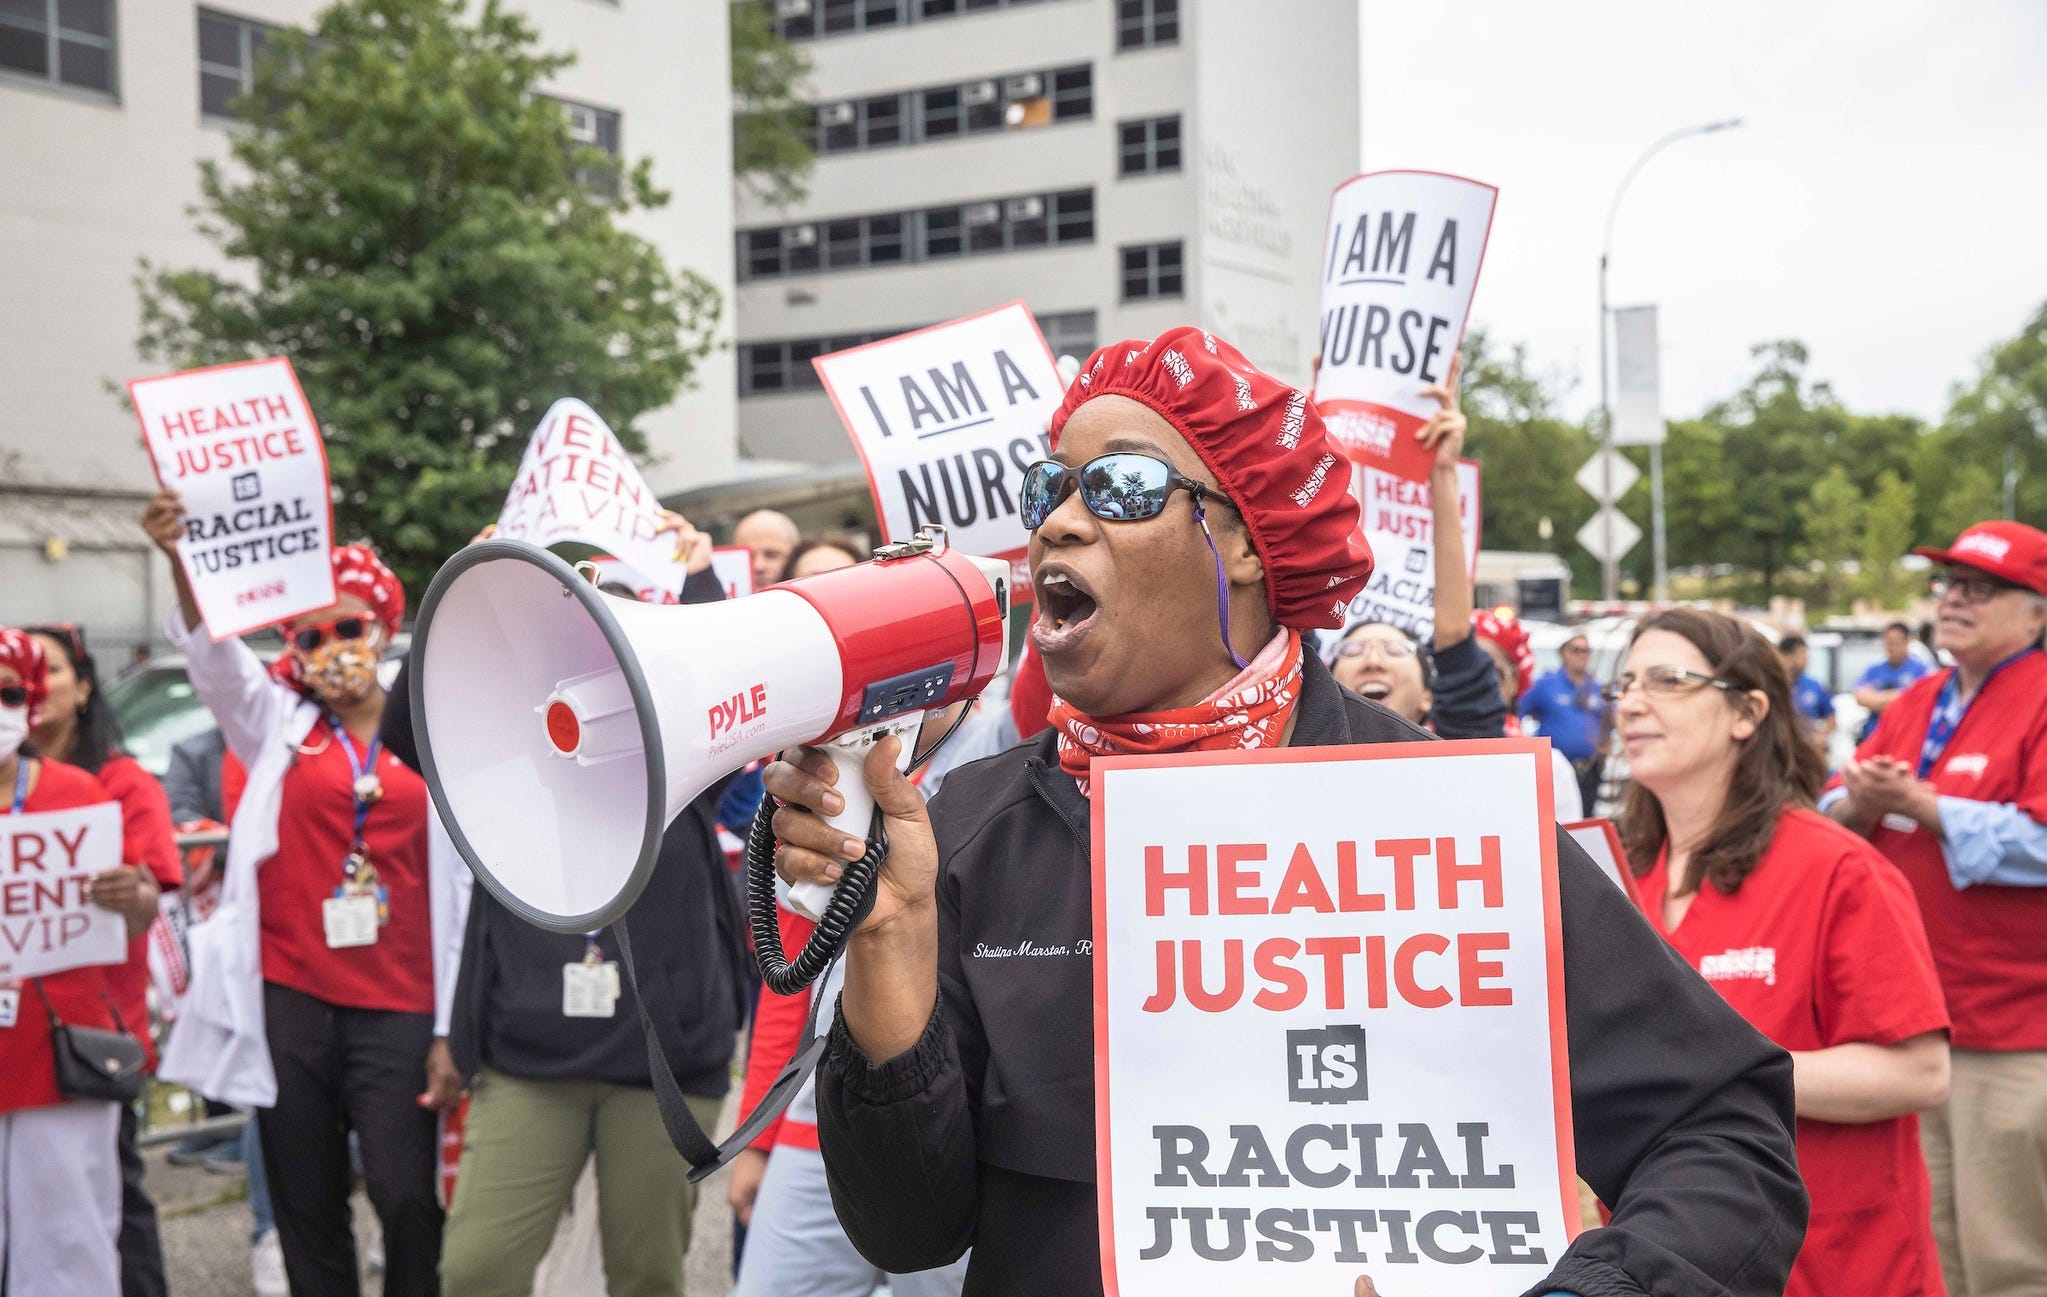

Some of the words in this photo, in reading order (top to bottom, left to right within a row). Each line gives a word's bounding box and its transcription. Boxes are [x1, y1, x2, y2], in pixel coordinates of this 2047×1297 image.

[1327, 223, 1342, 284] I
[1343, 211, 1417, 275] AM
[1427, 219, 1459, 286] A
[161, 394, 291, 442] HEALTH
[859, 386, 892, 437] I
[899, 361, 989, 430] AM
[993, 350, 1041, 406] A
[1281, 390, 1307, 450] NURSES
[176, 428, 306, 478] JUSTICE
[1295, 453, 1337, 508] NURSES
[898, 432, 1053, 534] NURS
[186, 500, 312, 543] RACIAL
[1377, 511, 1430, 542] JUST
[192, 527, 321, 577] JUSTICE
[708, 683, 767, 741] PYLE
[0, 826, 89, 875] RY
[1144, 836, 1504, 916] HEALTH
[1, 911, 91, 954] VIP
[1013, 940, 1070, 957] Marston,
[1142, 932, 1513, 1013] JUSTICE
[1297, 1044, 1359, 1089] IS
[1152, 1122, 1516, 1189] RACIAL
[1140, 1207, 1549, 1265] JUSTICE
